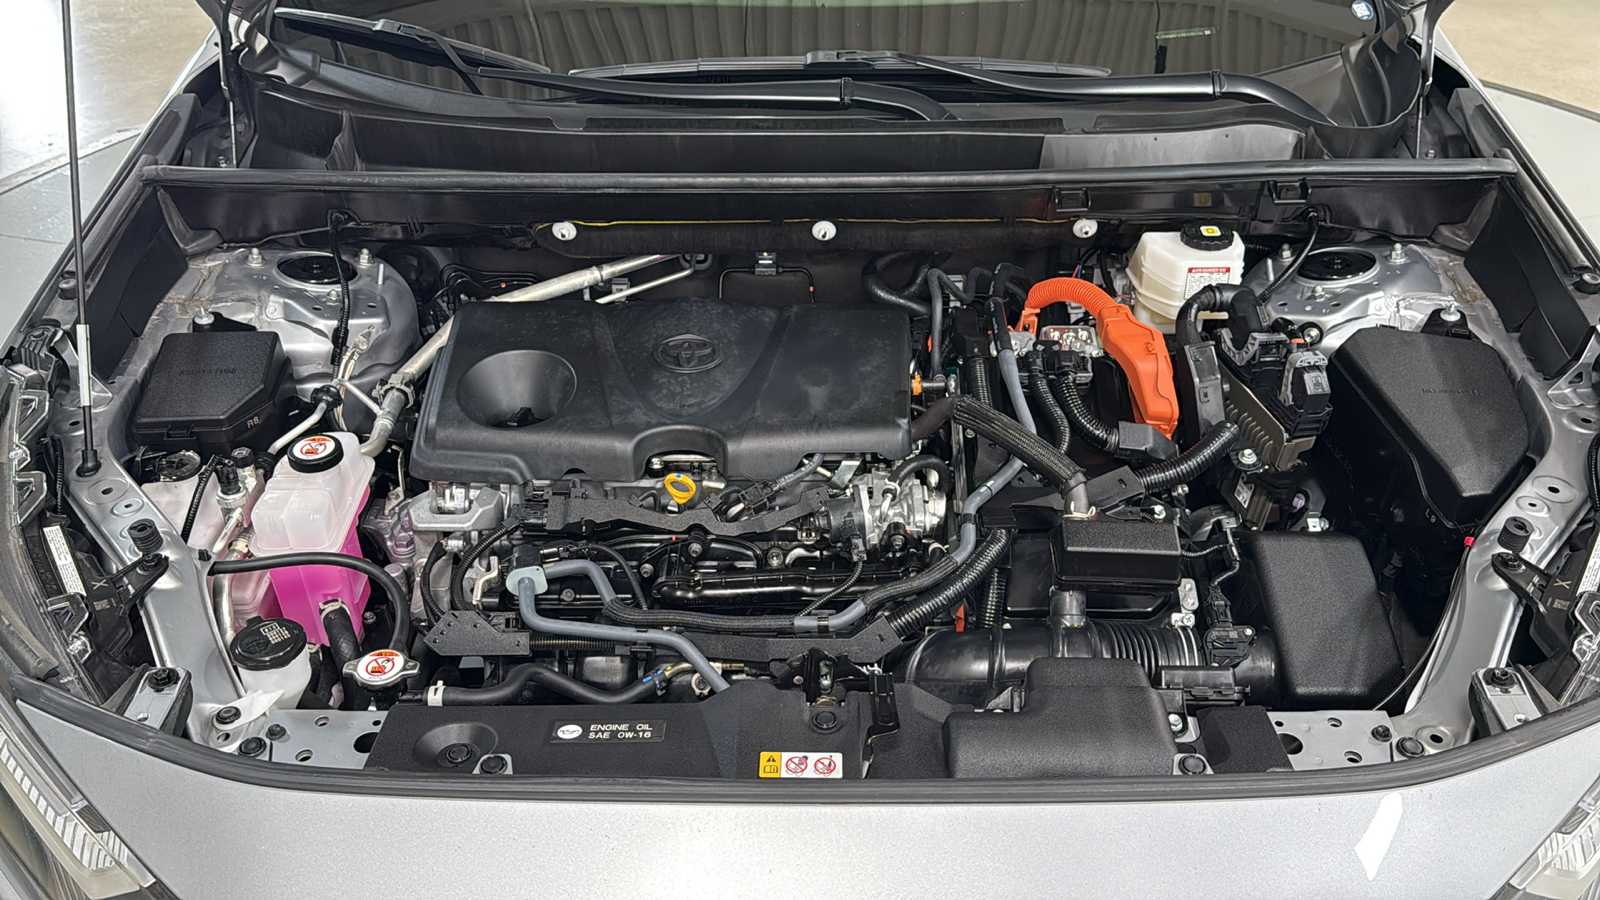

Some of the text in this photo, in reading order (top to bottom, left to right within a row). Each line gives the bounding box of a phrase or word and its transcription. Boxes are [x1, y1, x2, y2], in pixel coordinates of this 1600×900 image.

[246, 416, 260, 428] R8
[636, 723, 653, 731] OIL
[588, 731, 611, 739] SAE
